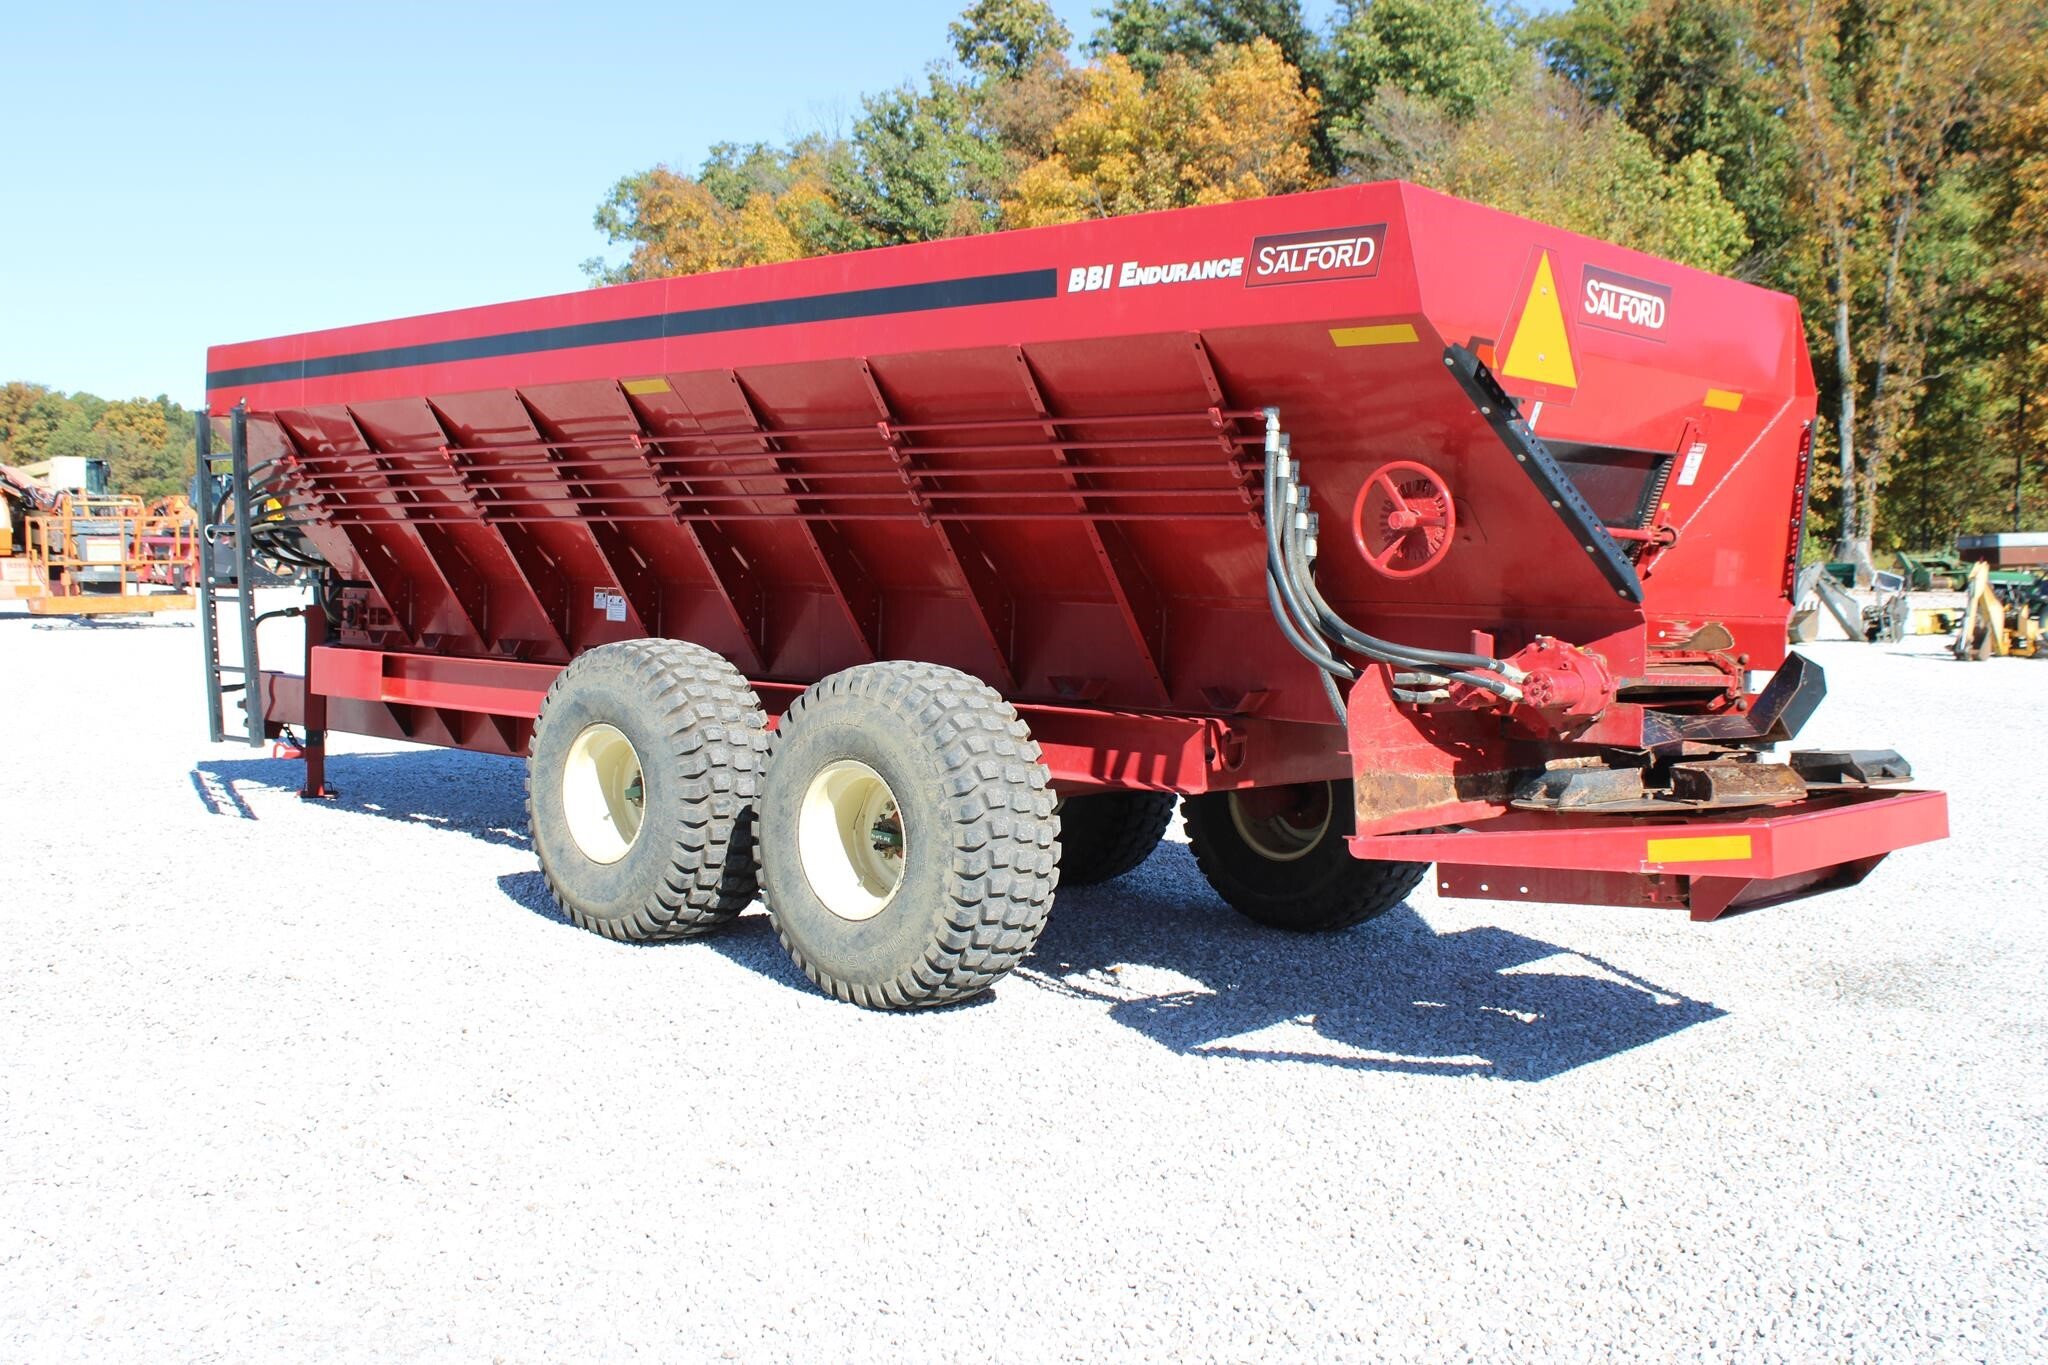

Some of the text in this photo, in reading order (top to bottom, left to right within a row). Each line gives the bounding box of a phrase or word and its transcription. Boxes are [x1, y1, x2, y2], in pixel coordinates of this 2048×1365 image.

[1067, 256, 1245, 293] BBI ENDURANCE
[1256, 237, 1375, 275] SALFORD
[1584, 278, 1665, 329] SALFORD
